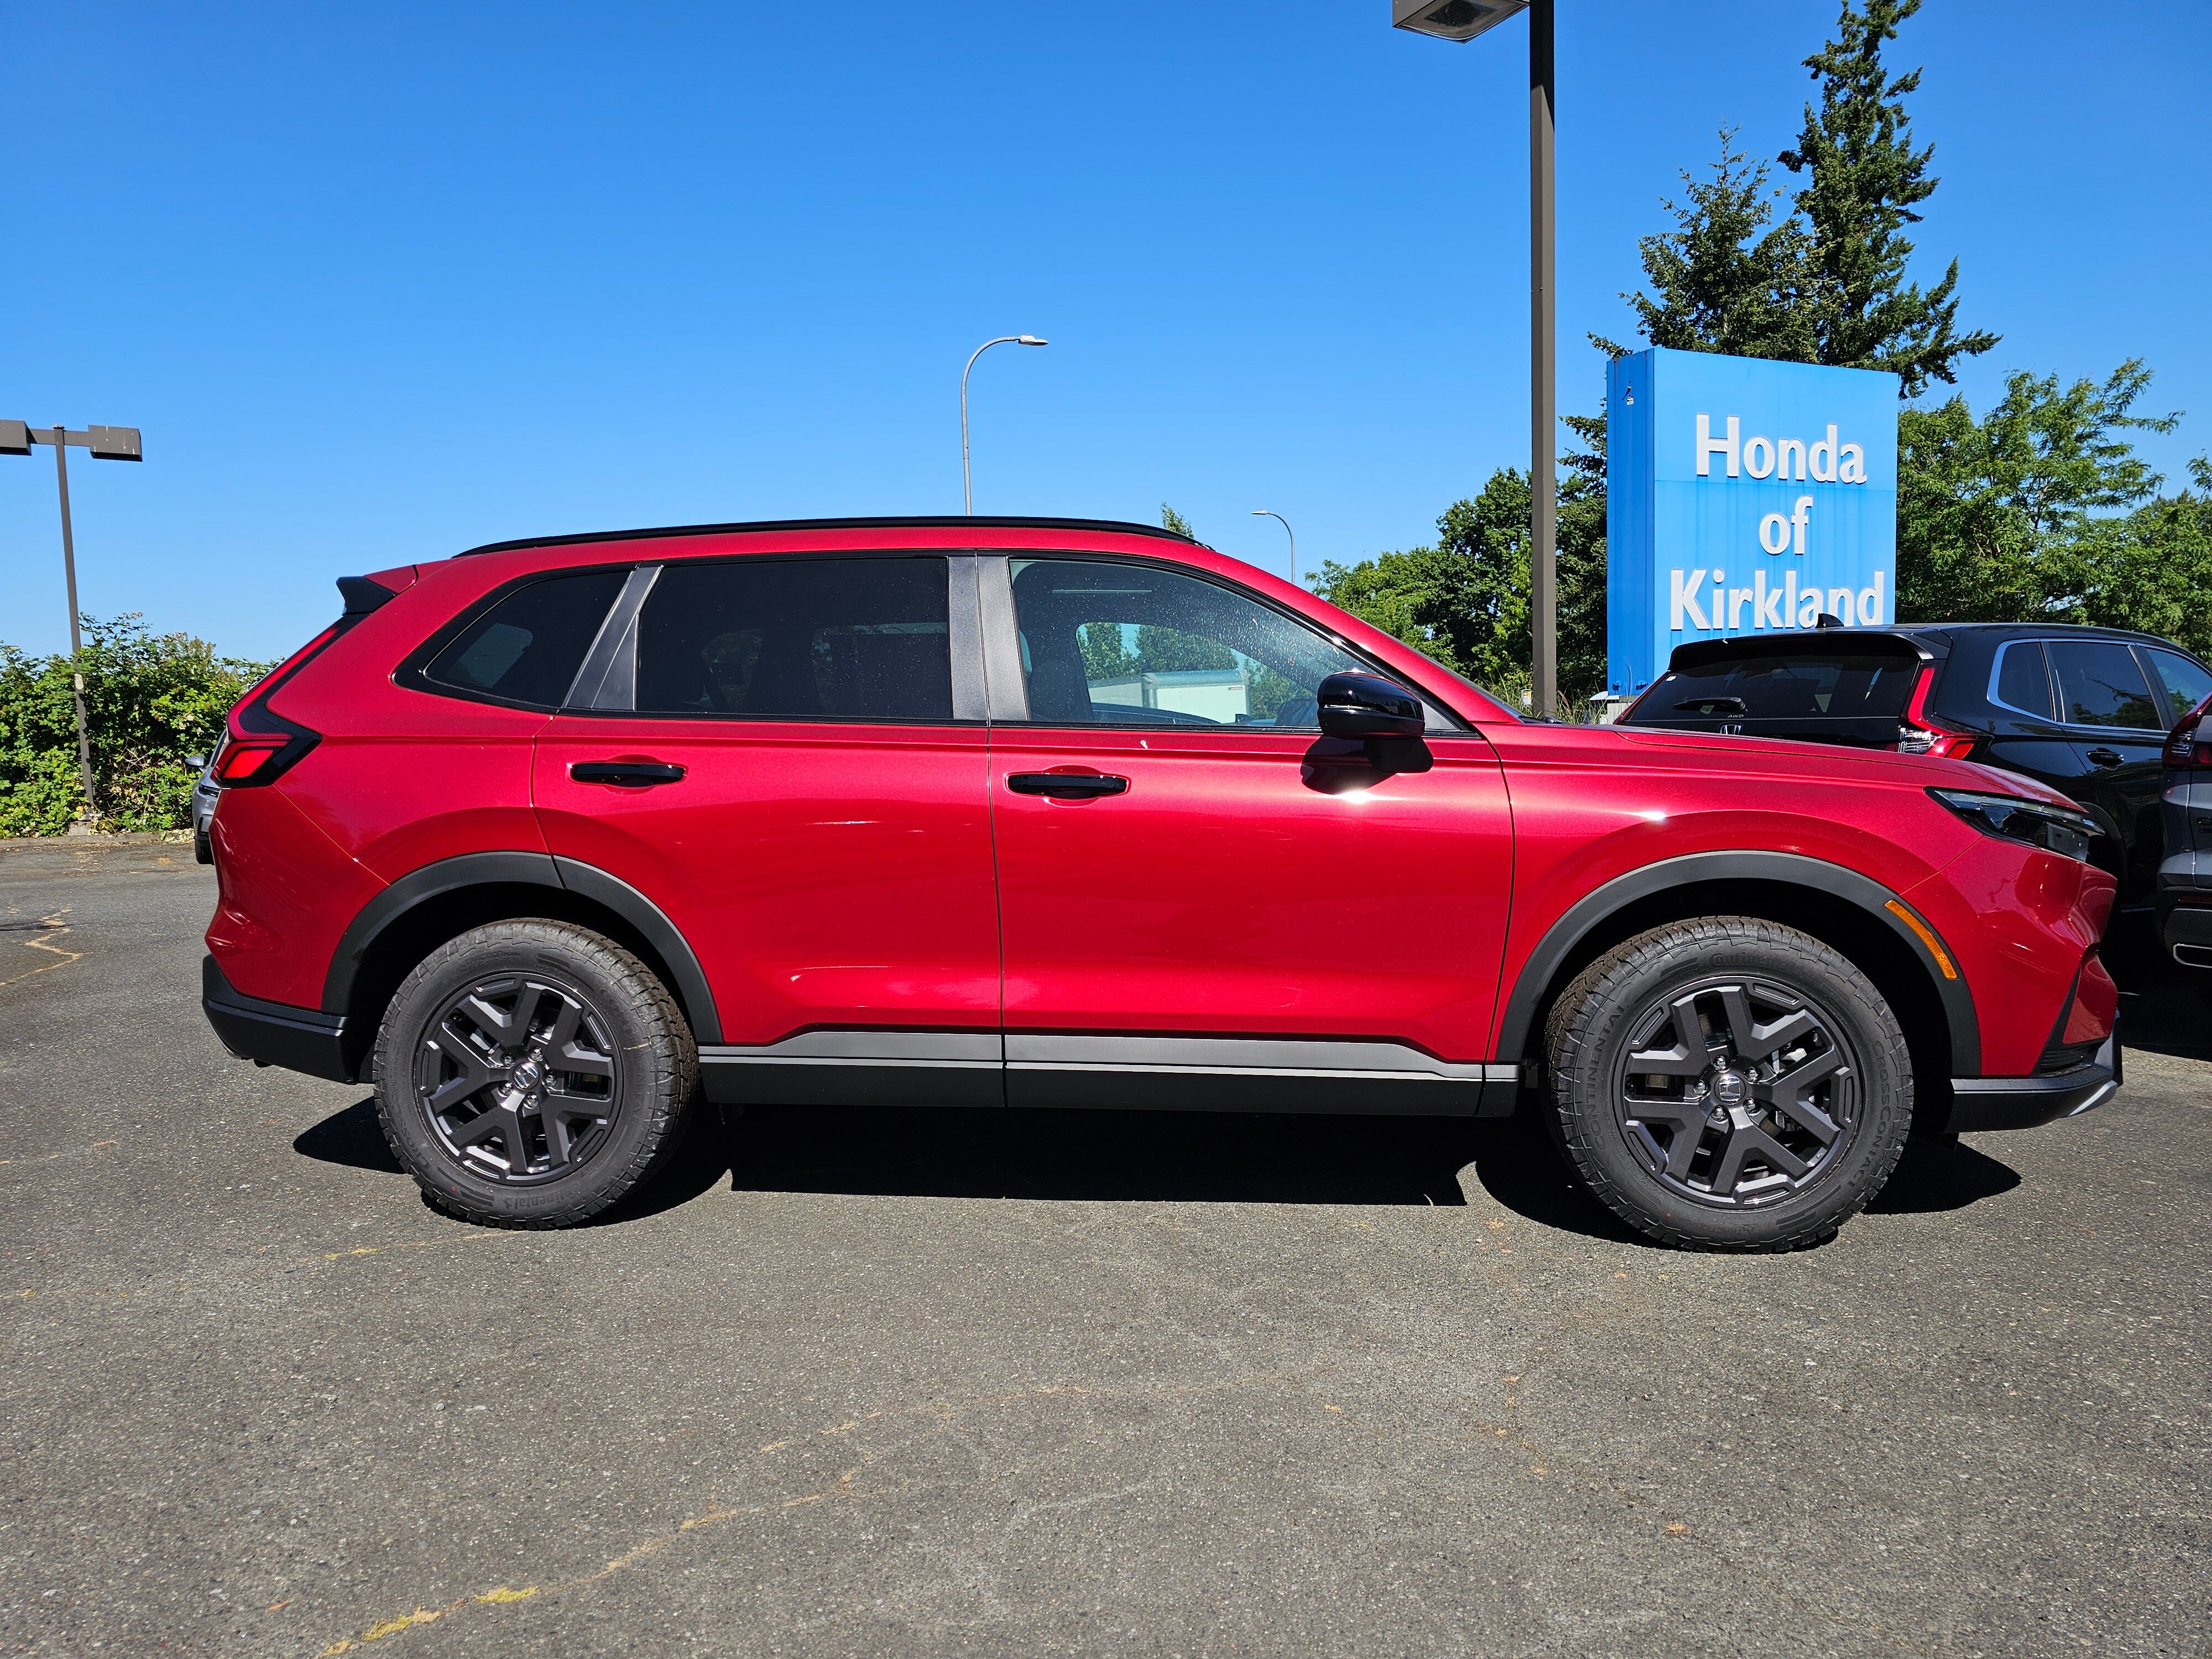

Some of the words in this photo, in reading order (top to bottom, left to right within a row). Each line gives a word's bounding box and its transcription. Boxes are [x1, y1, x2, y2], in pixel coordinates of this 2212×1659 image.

[1696, 413, 1867, 484] Honda
[1759, 495, 1813, 555] of
[1671, 568, 1884, 630] Kirkland
[1585, 1004, 1629, 1150] CONTINENTAL
